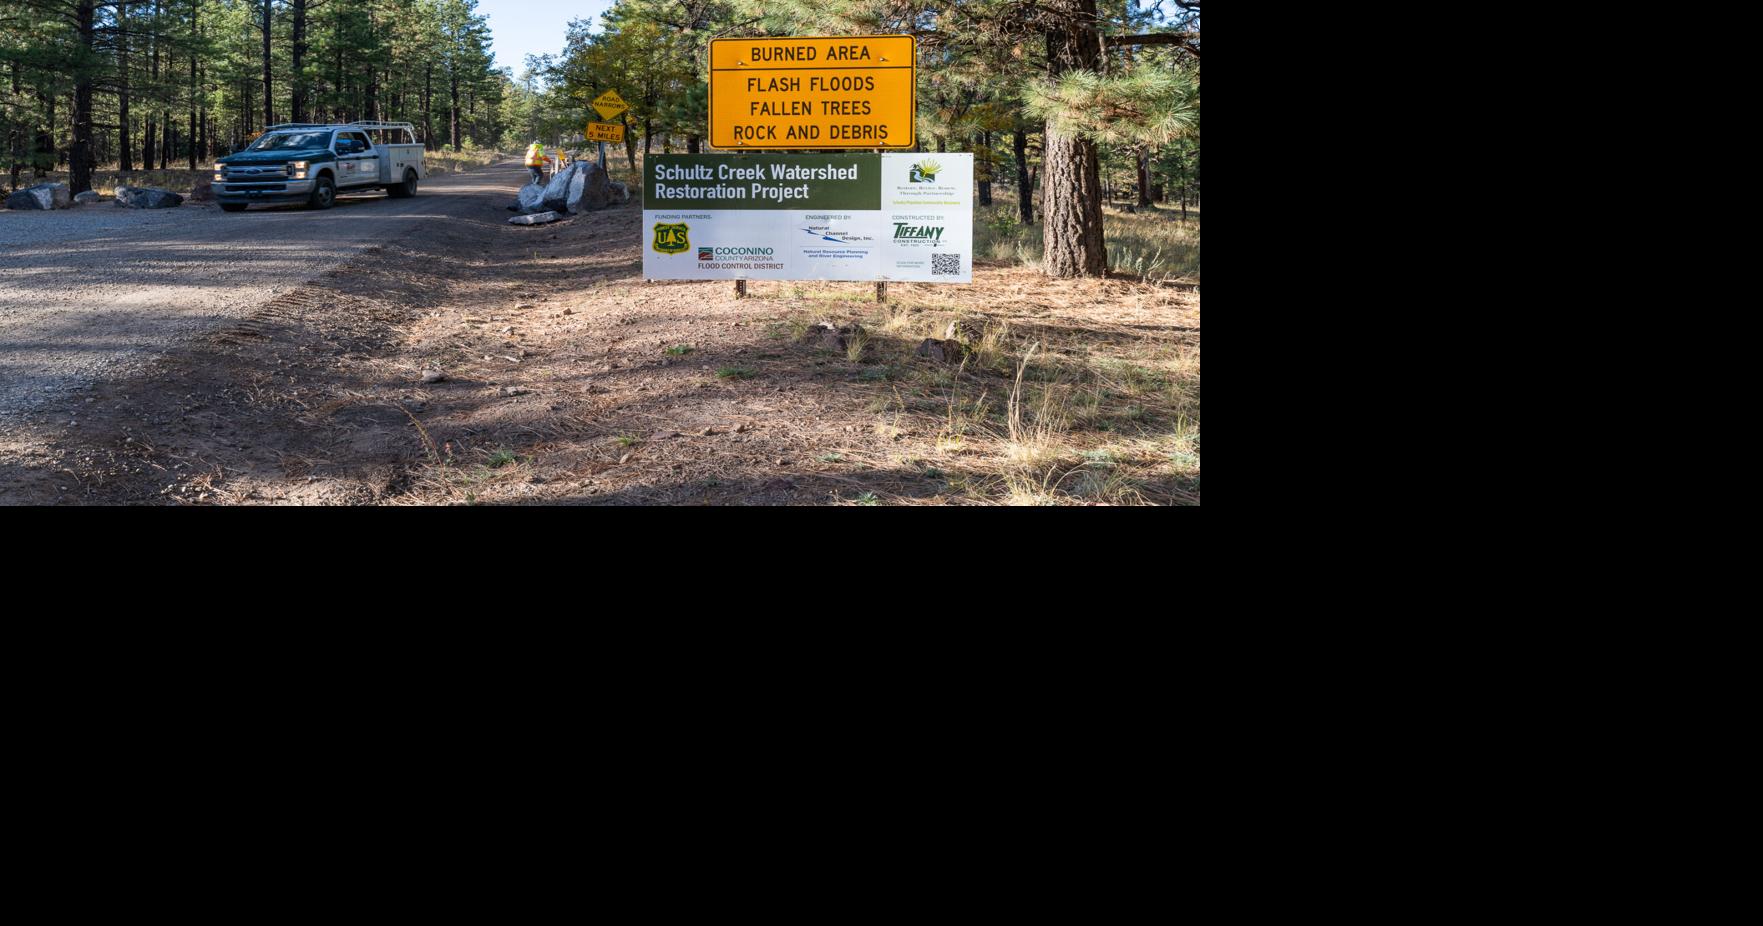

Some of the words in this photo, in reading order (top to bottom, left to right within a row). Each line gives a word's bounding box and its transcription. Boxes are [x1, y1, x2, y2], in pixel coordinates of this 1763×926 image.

[751, 47, 817, 62] BURNED
[826, 46, 871, 60] AREA
[747, 77, 800, 92] FLASH
[810, 76, 875, 91] FLOODS
[750, 101, 812, 116] FALLEN
[821, 101, 871, 115] TREES
[733, 125, 777, 140] ROCK
[786, 125, 820, 139] AND
[830, 124, 888, 139] DEBRIS
[655, 163, 713, 180] Schultz
[718, 163, 766, 180] Creek
[770, 163, 858, 180] Watershed
[655, 183, 746, 199] Restoration
[751, 183, 809, 202] Project
[893, 222, 945, 241] TIFFANY
[715, 247, 774, 255] COCONINO
